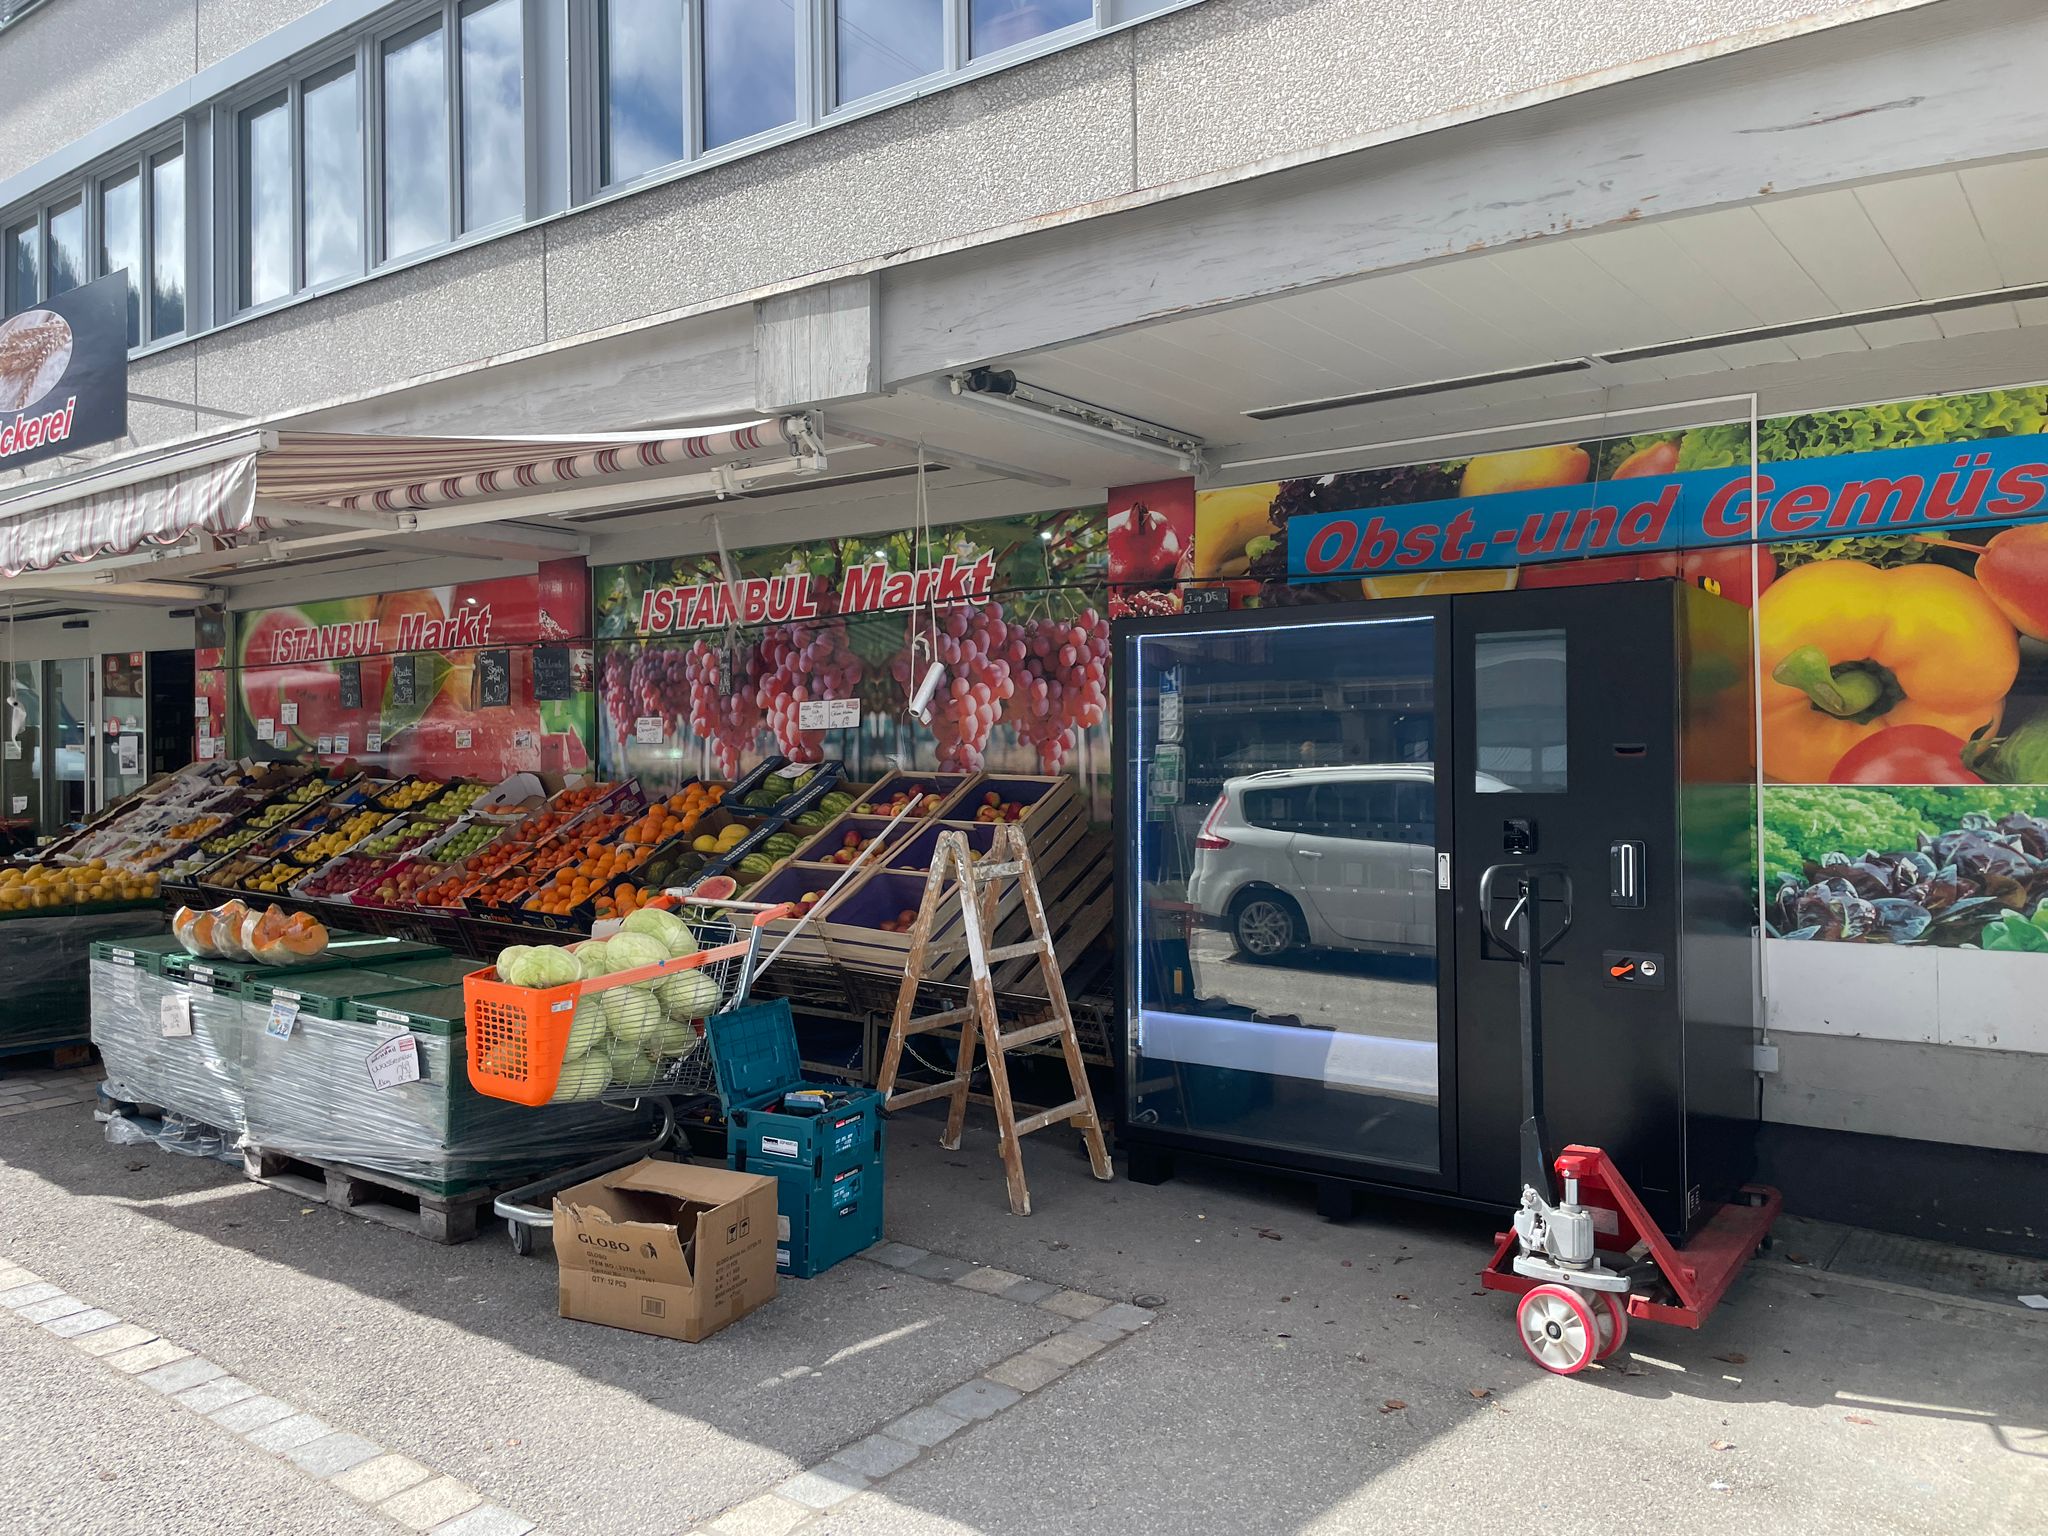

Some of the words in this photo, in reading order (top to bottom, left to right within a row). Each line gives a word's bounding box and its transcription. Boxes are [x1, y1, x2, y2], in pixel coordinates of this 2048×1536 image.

[0, 395, 77, 458] ckerei
[638, 572, 818, 633] ISTANBUL
[839, 547, 996, 614] Markt
[270, 619, 384, 664] ISTANBUL
[397, 603, 492, 651] Markt
[577, 1233, 630, 1252] GLOBO
